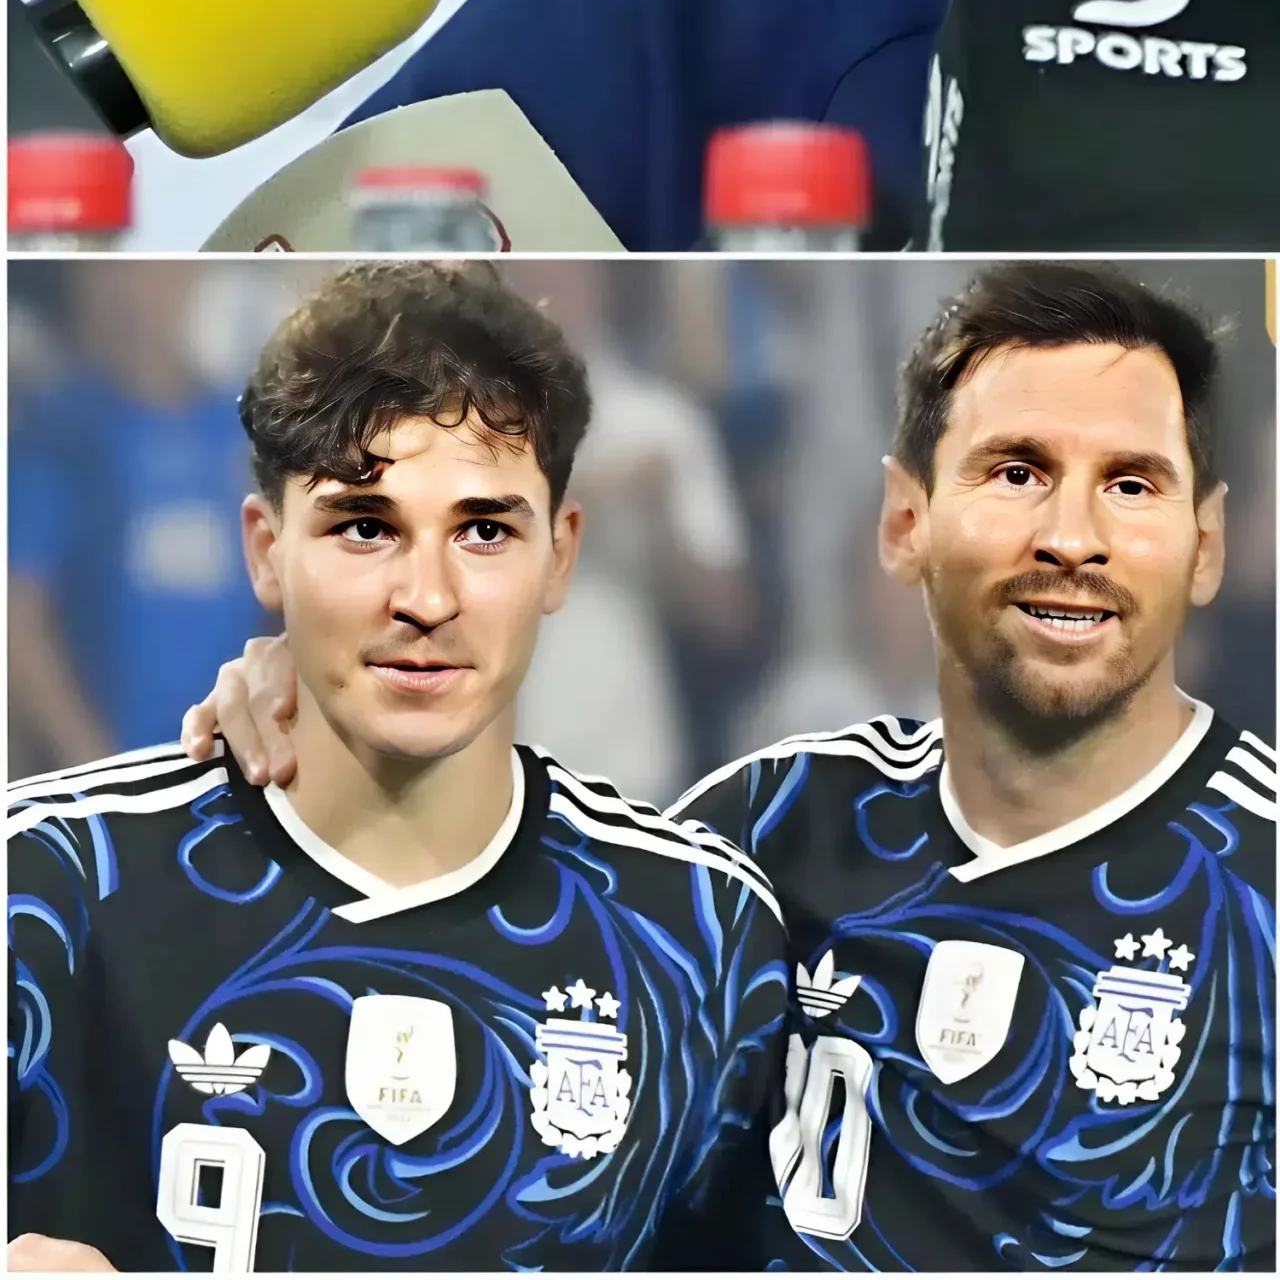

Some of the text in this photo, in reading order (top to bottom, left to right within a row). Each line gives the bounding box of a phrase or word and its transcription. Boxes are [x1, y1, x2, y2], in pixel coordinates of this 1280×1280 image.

[1022, 23, 1247, 81] SPORTS
[939, 1028, 976, 1047] FIFA
[1097, 1003, 1154, 1063] AFA
[379, 1087, 422, 1104] FIFA
[556, 1057, 610, 1117] AFA
[156, 1122, 267, 1273] 9
